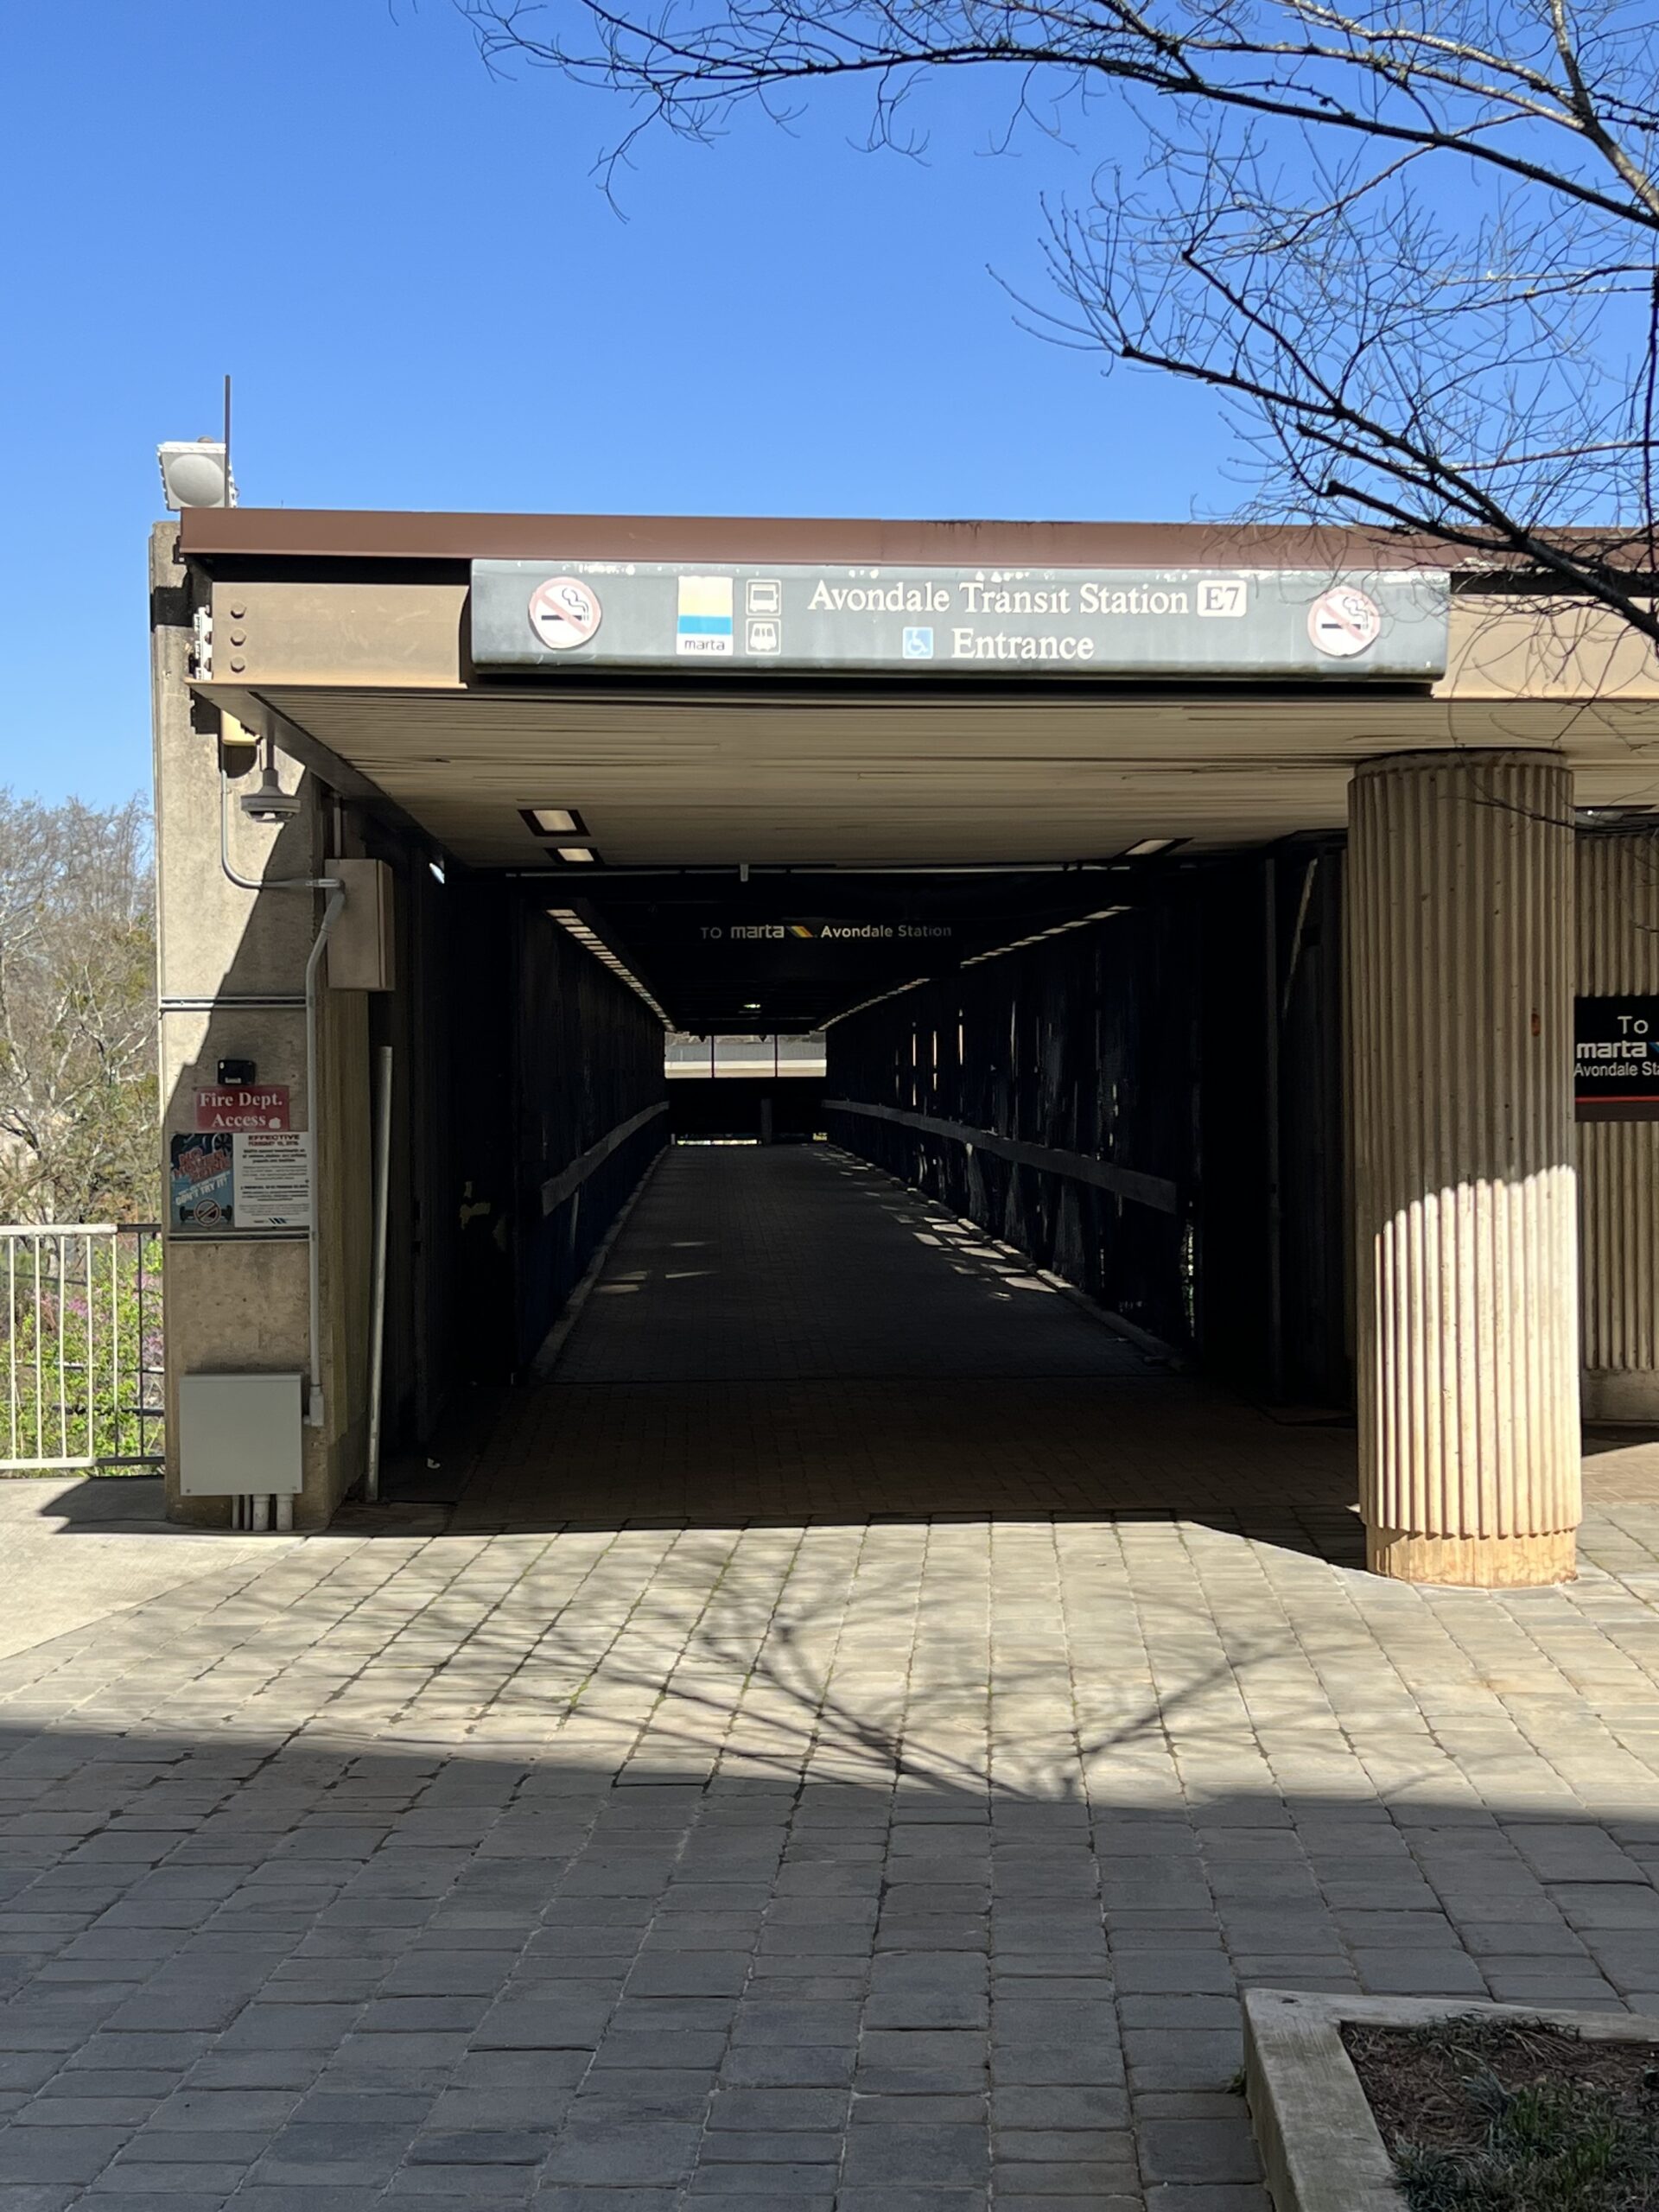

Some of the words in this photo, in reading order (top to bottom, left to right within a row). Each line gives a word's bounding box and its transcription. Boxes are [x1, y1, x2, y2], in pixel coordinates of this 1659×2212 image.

[808, 580, 949, 613] Avondale
[959, 582, 1071, 613] Transit
[1080, 583, 1188, 614] Station
[1205, 588, 1239, 613] E7
[683, 638, 726, 652] marta
[951, 628, 1095, 659] Entrance
[700, 926, 721, 939] TO
[730, 925, 785, 939] marta
[821, 925, 893, 938] Avondale
[898, 925, 952, 938] Station
[1617, 1015, 1649, 1034] To
[1576, 1039, 1647, 1059] marta
[1573, 1062, 1638, 1077] Avondale
[200, 1092, 234, 1107] Fire
[238, 1092, 283, 1109] Dept.
[212, 1113, 266, 1128] Access
[200, 1181, 215, 1196] TRY
